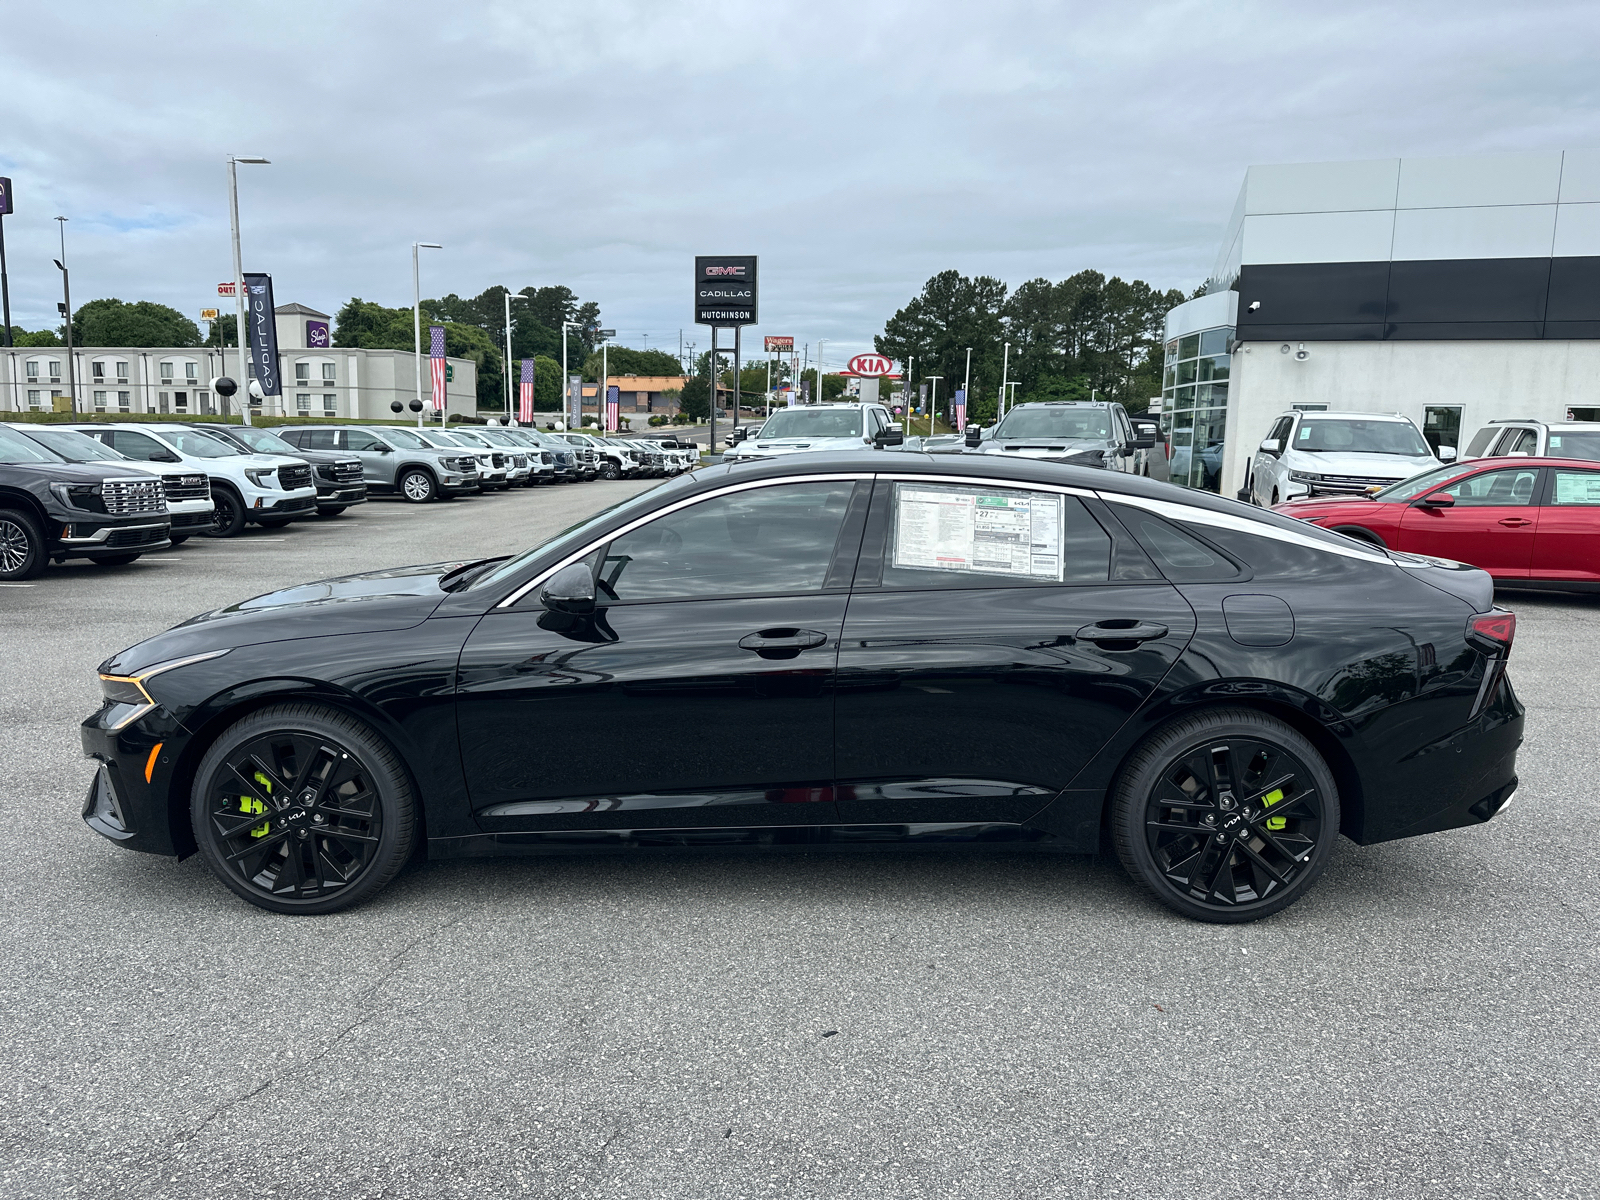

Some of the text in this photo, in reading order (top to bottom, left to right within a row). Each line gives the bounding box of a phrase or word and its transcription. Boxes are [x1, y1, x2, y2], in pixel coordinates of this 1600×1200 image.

[706, 266, 746, 276] GMC
[699, 290, 752, 298] CADILLAC
[701, 311, 750, 319] HUTCHINSON
[310, 329, 326, 344] Sleep
[766, 336, 793, 345] Wagers
[856, 358, 886, 373] KIA
[979, 510, 989, 518] 27
